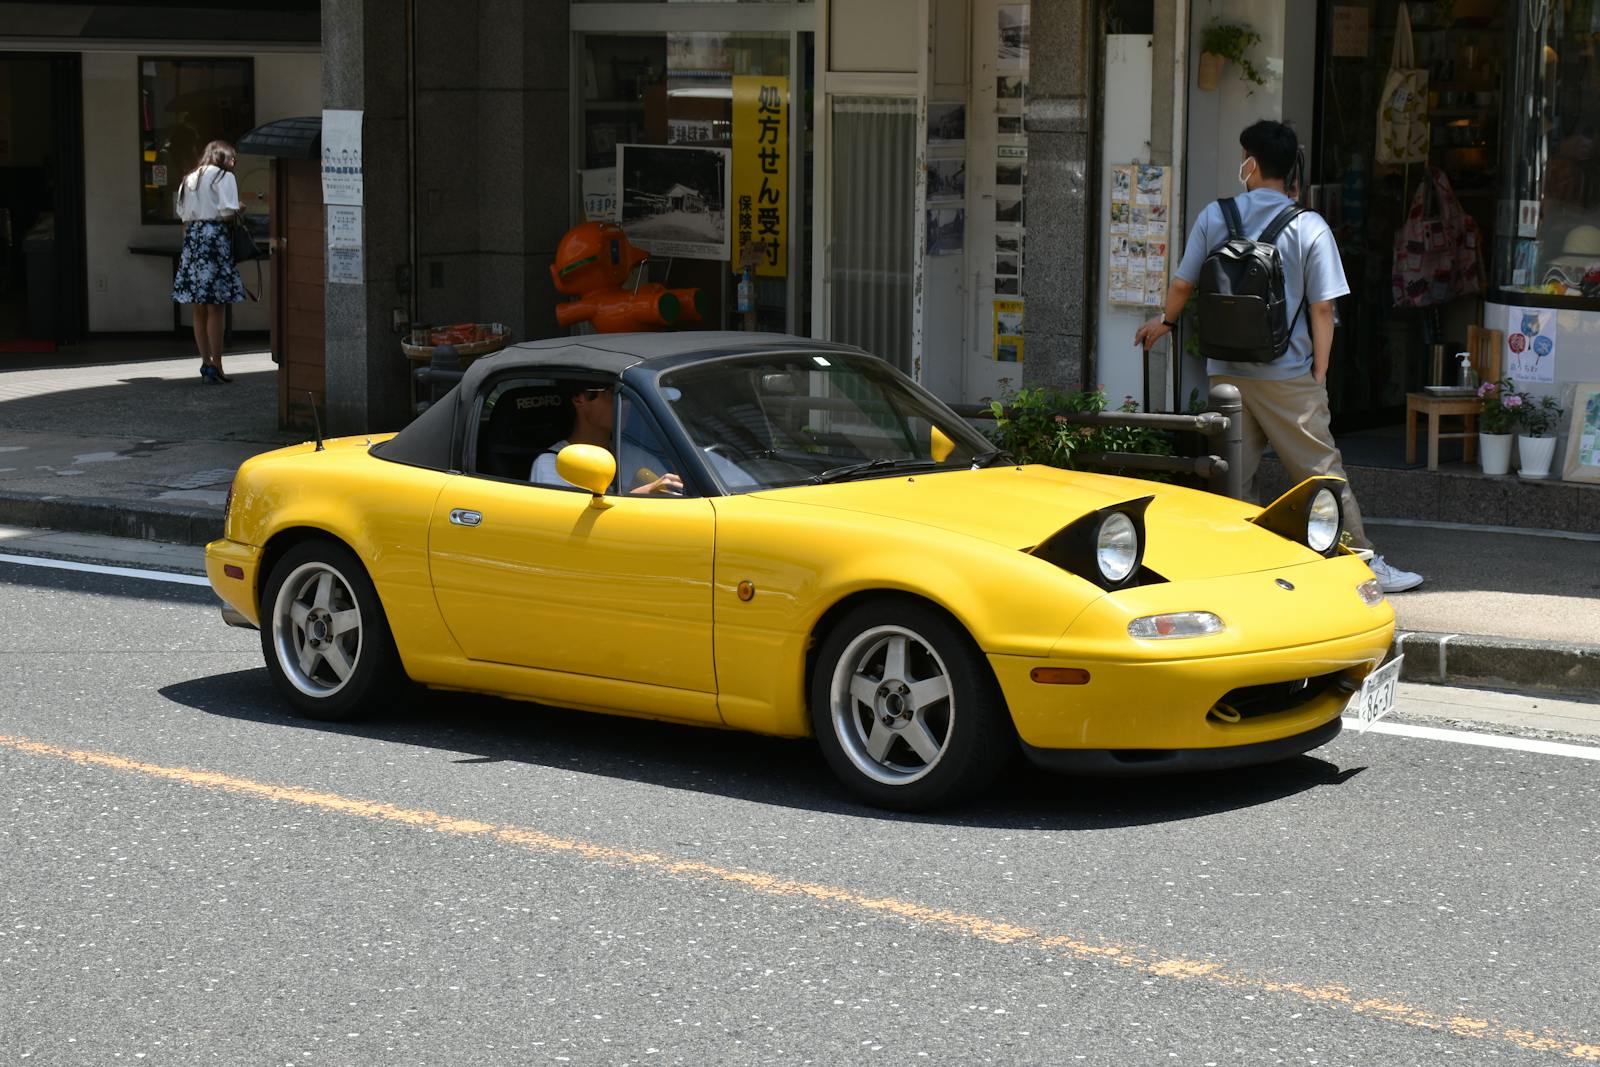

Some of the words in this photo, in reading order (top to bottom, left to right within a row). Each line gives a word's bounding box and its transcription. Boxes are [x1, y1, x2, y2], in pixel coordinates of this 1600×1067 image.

[758, 86, 781, 265] 処方せん受付
[517, 395, 561, 411] RECARO
